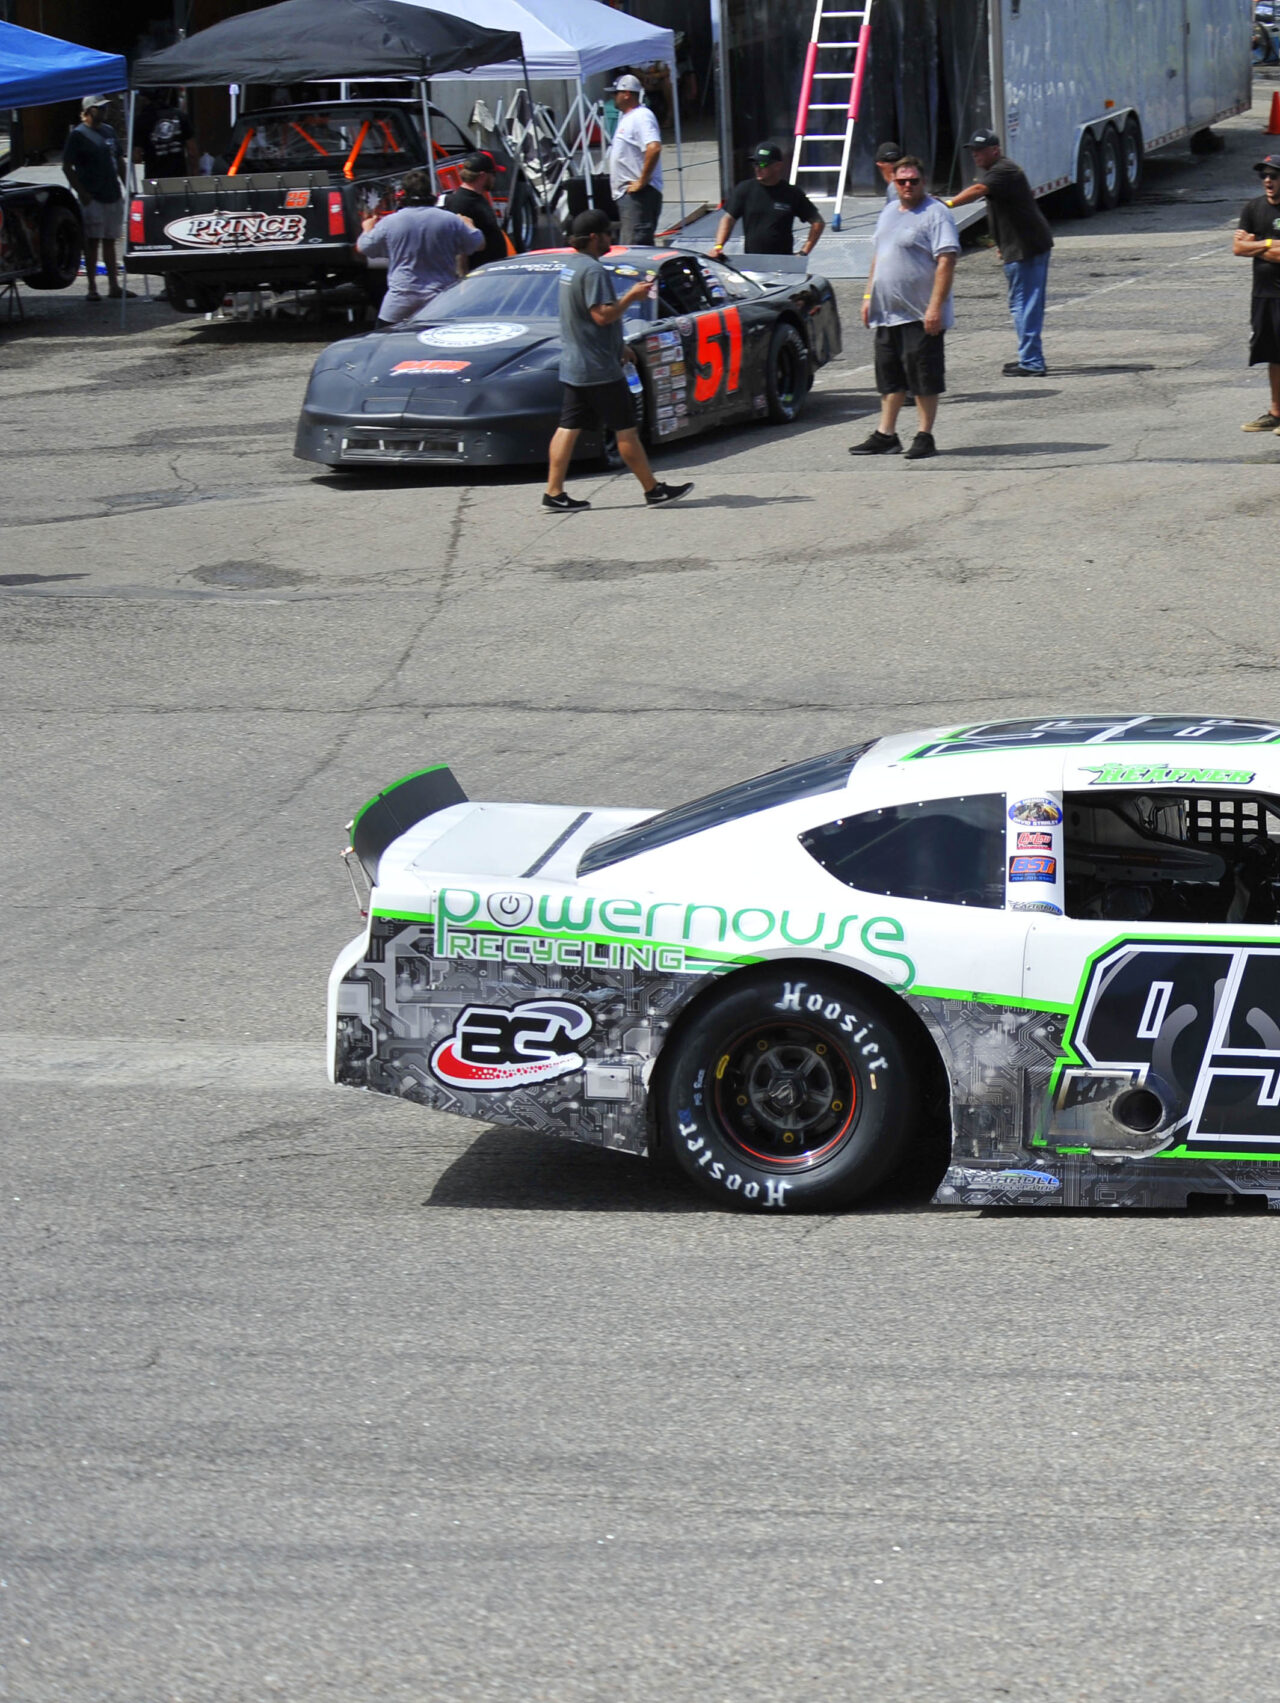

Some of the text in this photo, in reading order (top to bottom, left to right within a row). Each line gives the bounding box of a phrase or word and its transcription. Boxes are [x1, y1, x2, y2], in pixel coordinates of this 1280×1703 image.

[285, 191, 310, 208] 25
[188, 216, 300, 236] PRINCE
[693, 306, 743, 403] 51
[1096, 767, 1256, 785] HEAFNER
[1011, 857, 1055, 873] BST
[449, 936, 685, 969] RECYCLING
[774, 981, 889, 1071] Hoosier
[678, 1121, 793, 1208] Hoosier
